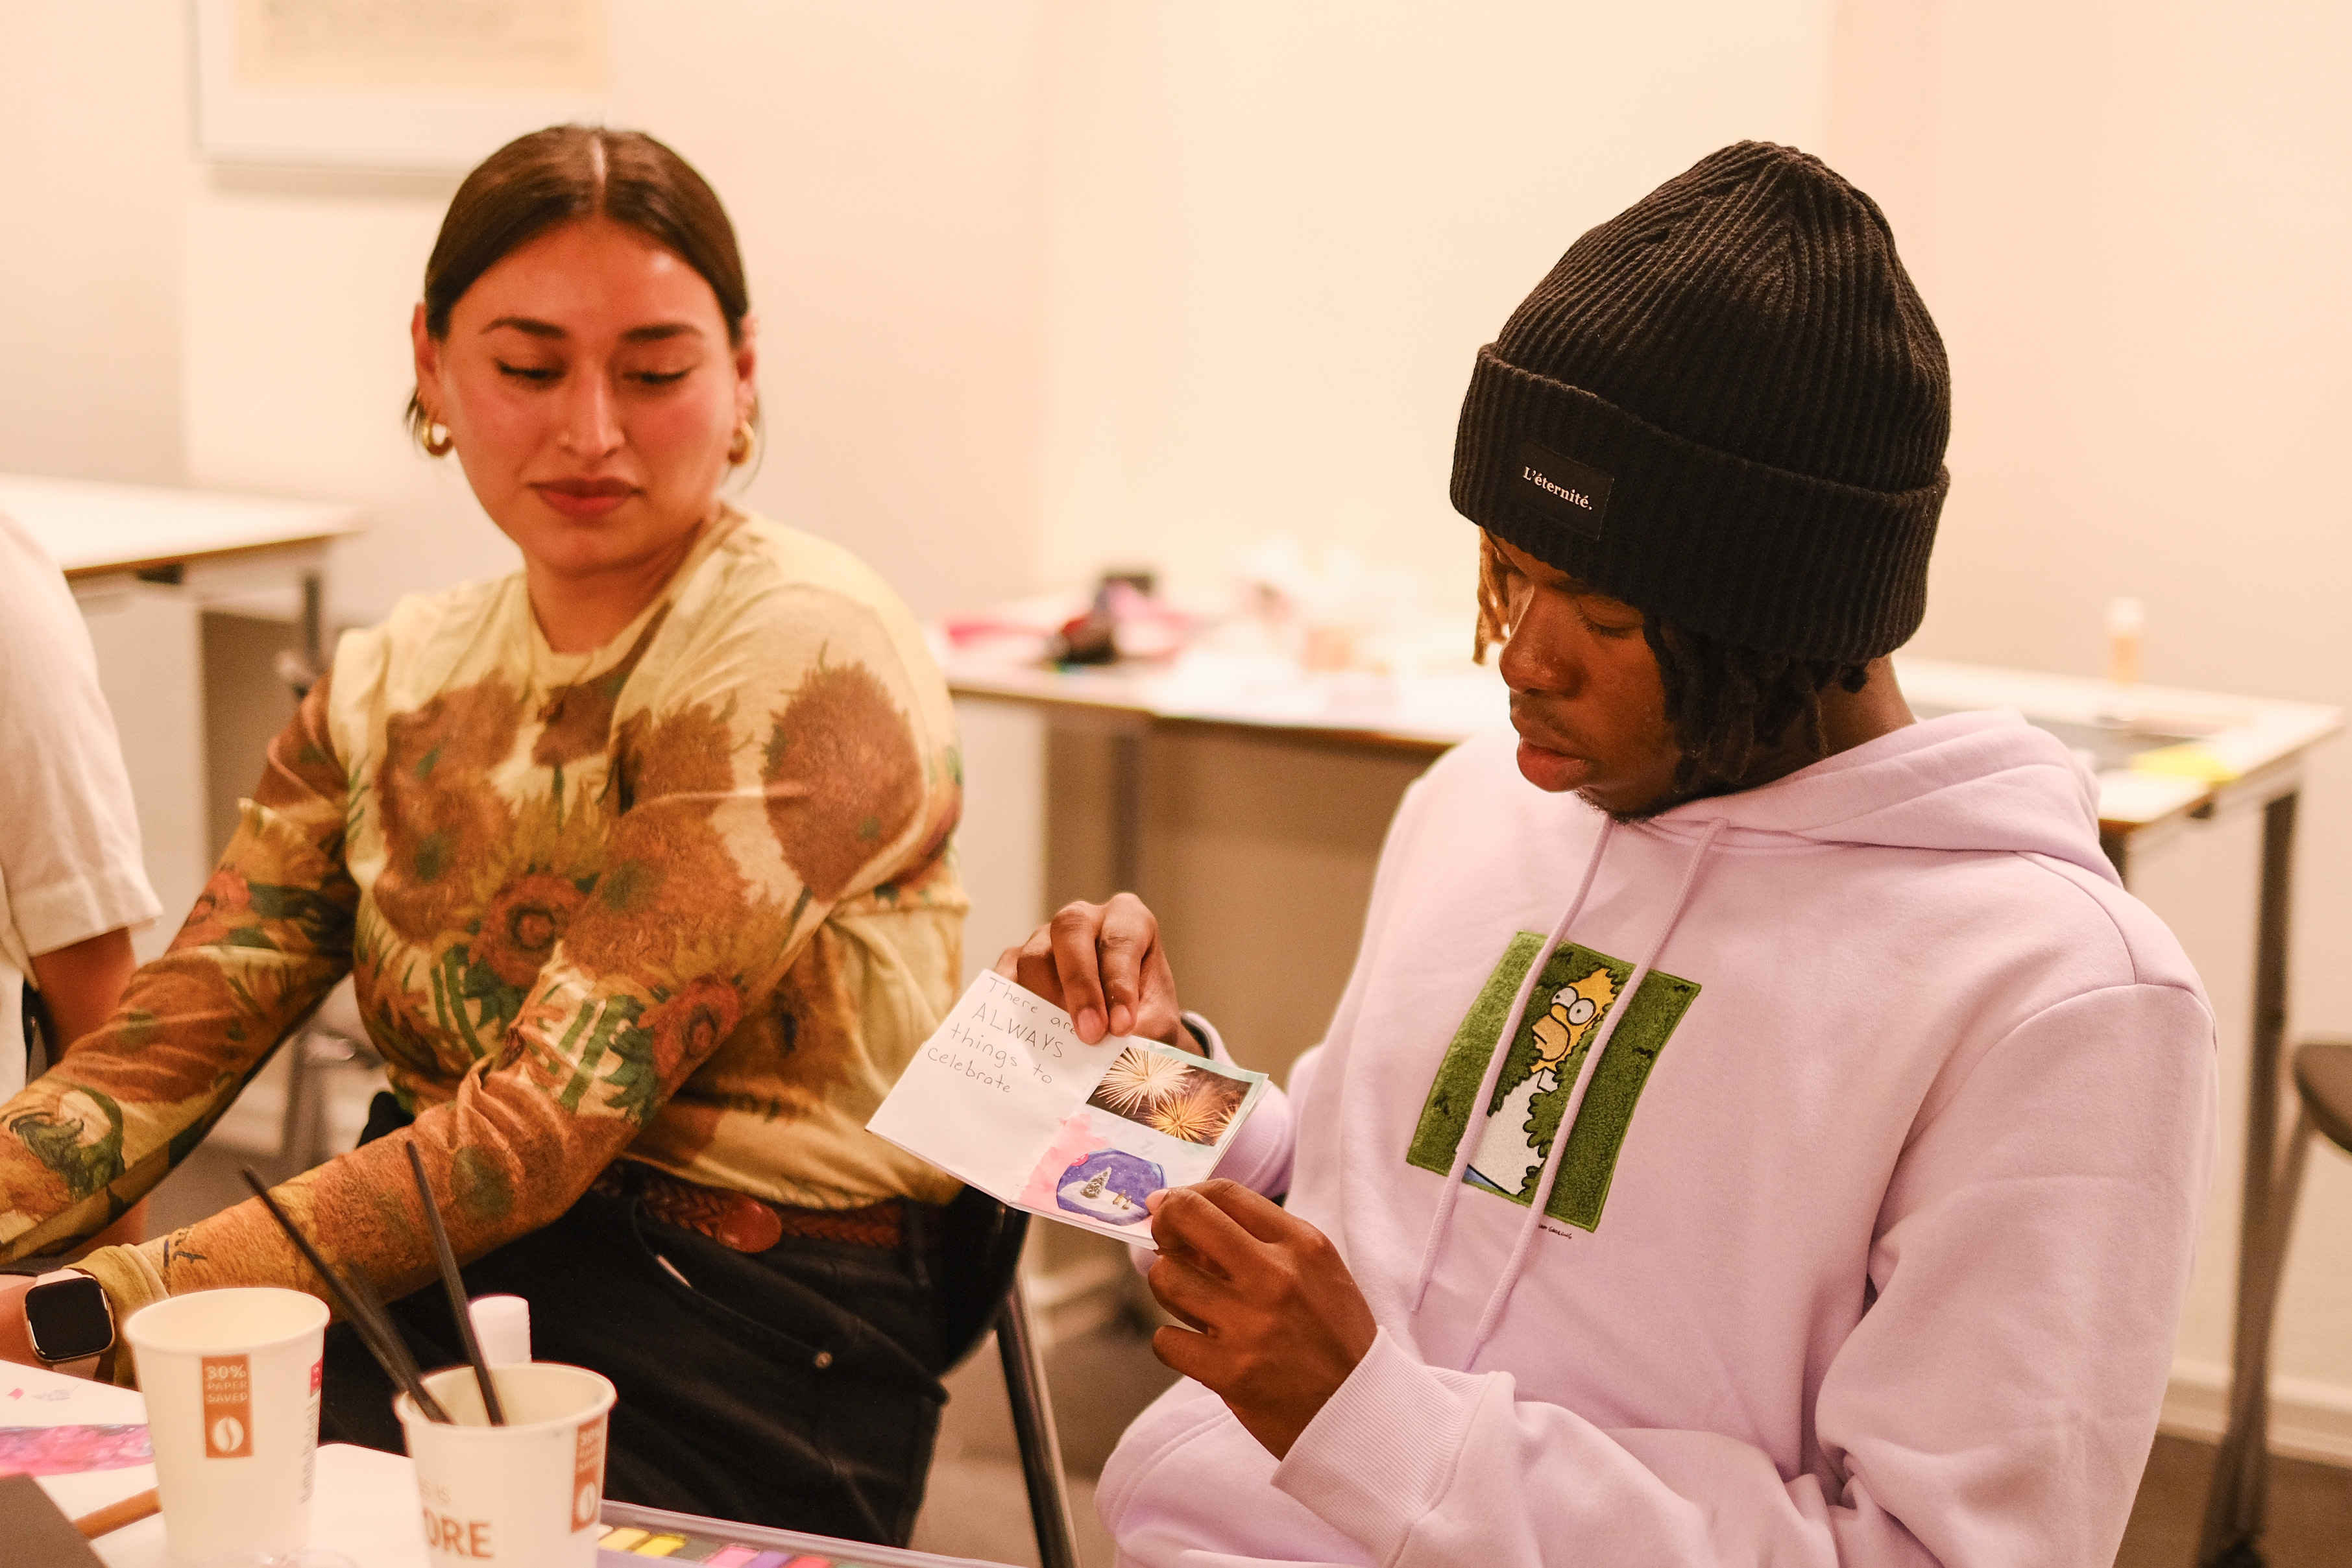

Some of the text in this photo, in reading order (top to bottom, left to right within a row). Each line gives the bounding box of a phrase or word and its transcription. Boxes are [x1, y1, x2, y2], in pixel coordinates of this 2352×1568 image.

[989, 976, 1038, 1013] There
[972, 1003, 1063, 1058] ALWAYS
[951, 1023, 1052, 1084] things to
[206, 1364, 247, 1381] 30%
[208, 1381, 248, 1390] PAPER
[208, 1392, 248, 1403] SAVED
